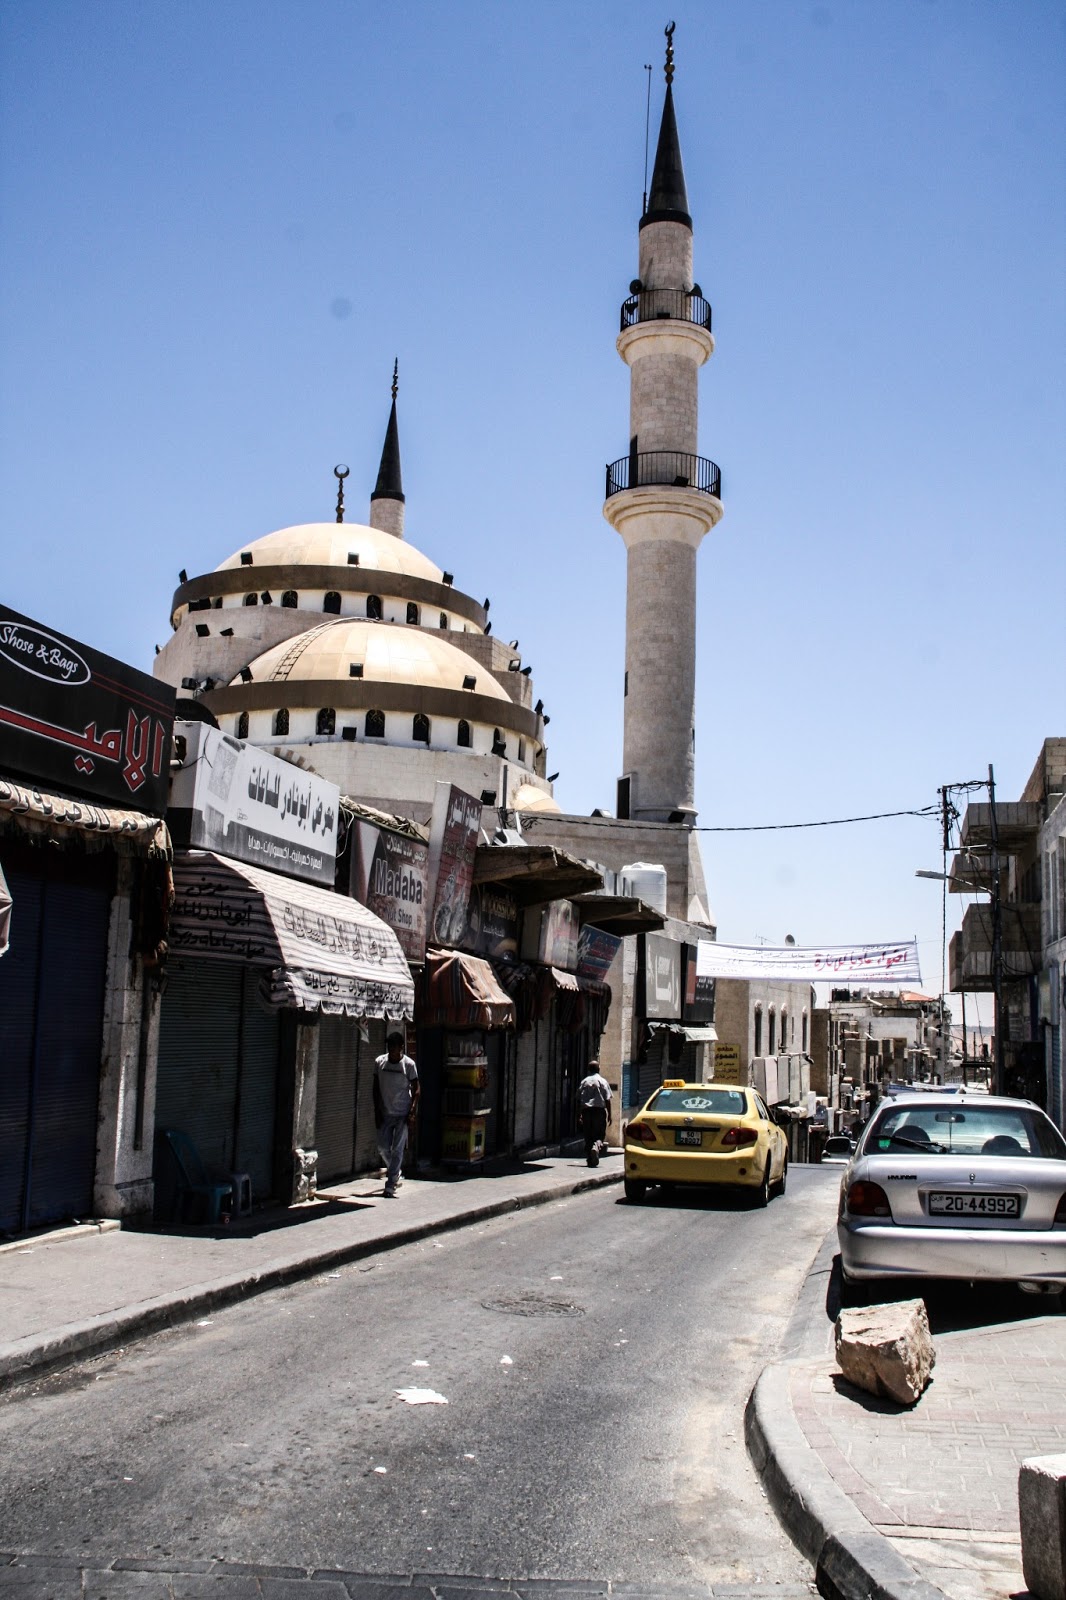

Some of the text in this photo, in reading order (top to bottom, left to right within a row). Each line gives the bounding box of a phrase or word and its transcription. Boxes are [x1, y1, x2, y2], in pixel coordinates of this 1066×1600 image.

[0, 626, 34, 654] Shose
[312, 796, 335, 837] معرض
[375, 857, 423, 905] Madaba
[398, 908, 412, 927] Shop
[945, 1196, 1016, 1213] 20-44992
